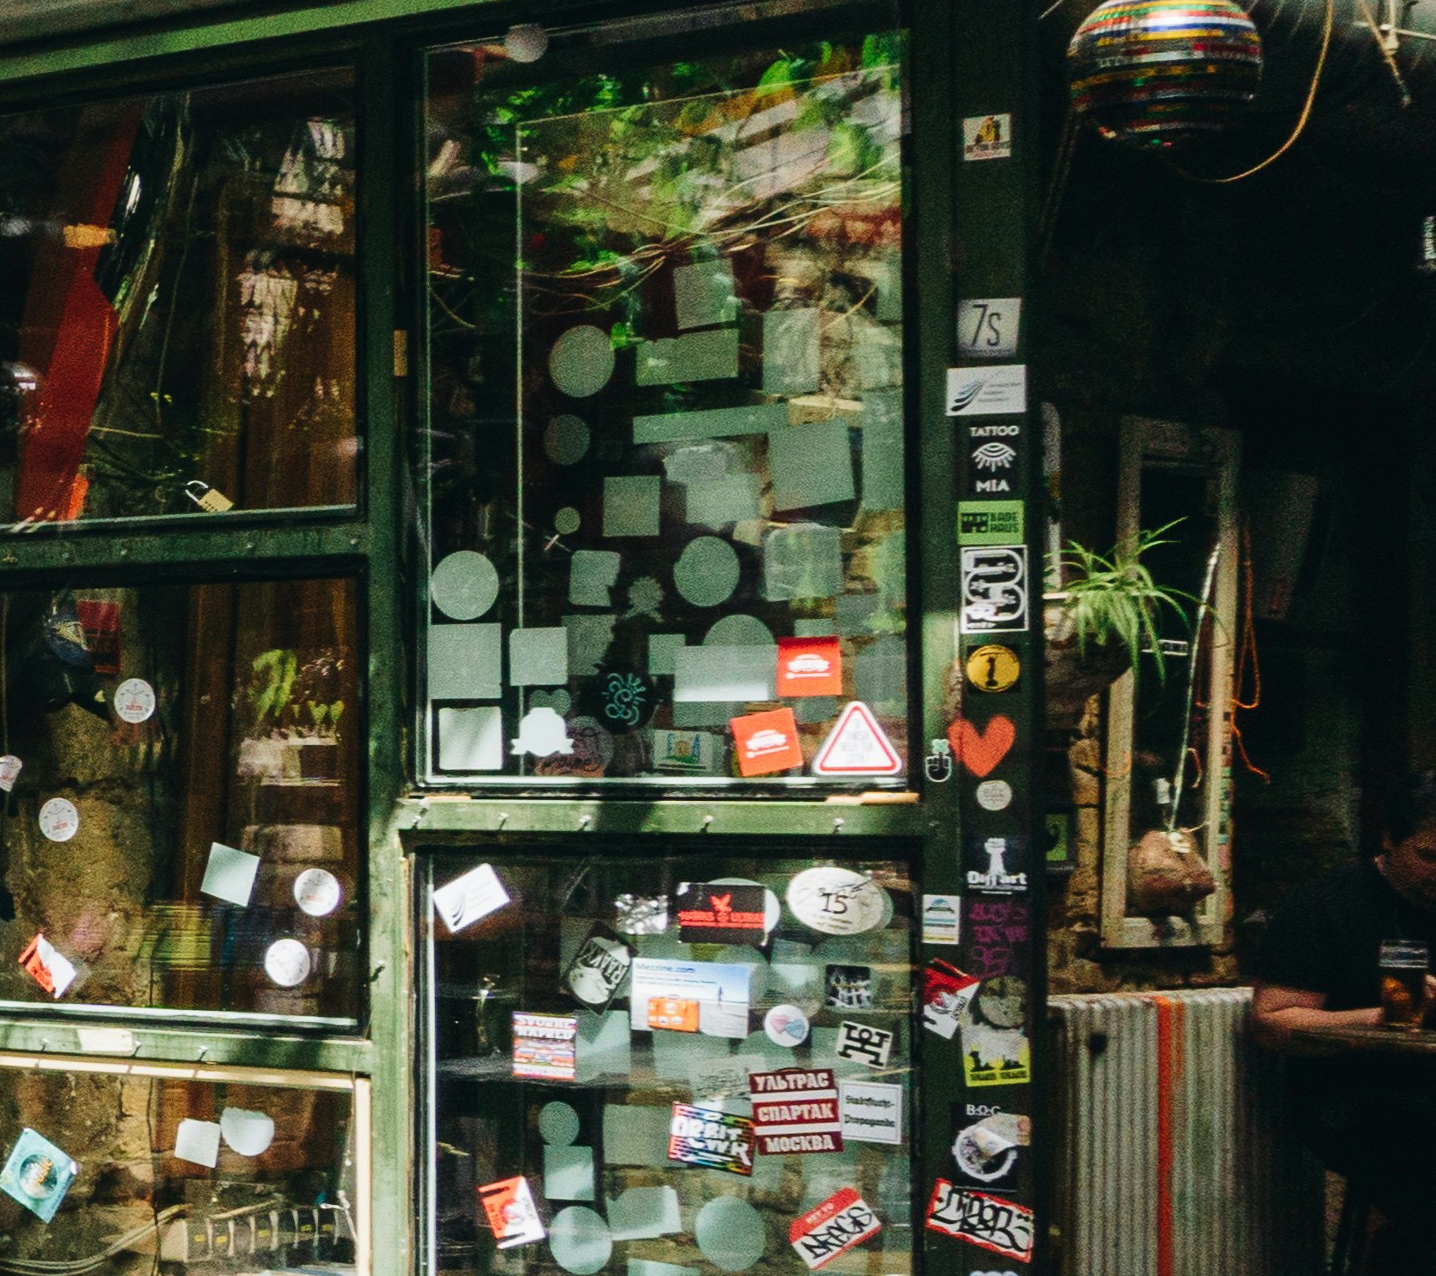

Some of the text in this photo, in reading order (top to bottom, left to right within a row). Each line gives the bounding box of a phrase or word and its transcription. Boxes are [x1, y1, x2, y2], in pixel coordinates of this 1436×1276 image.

[969, 425, 1021, 437] TATTOO
[976, 479, 1011, 493] MIA
[754, 1072, 830, 1092] УЛЬТРАС
[758, 1104, 834, 1123] СПАРТАК
[764, 1134, 835, 1154] МОСКВА
